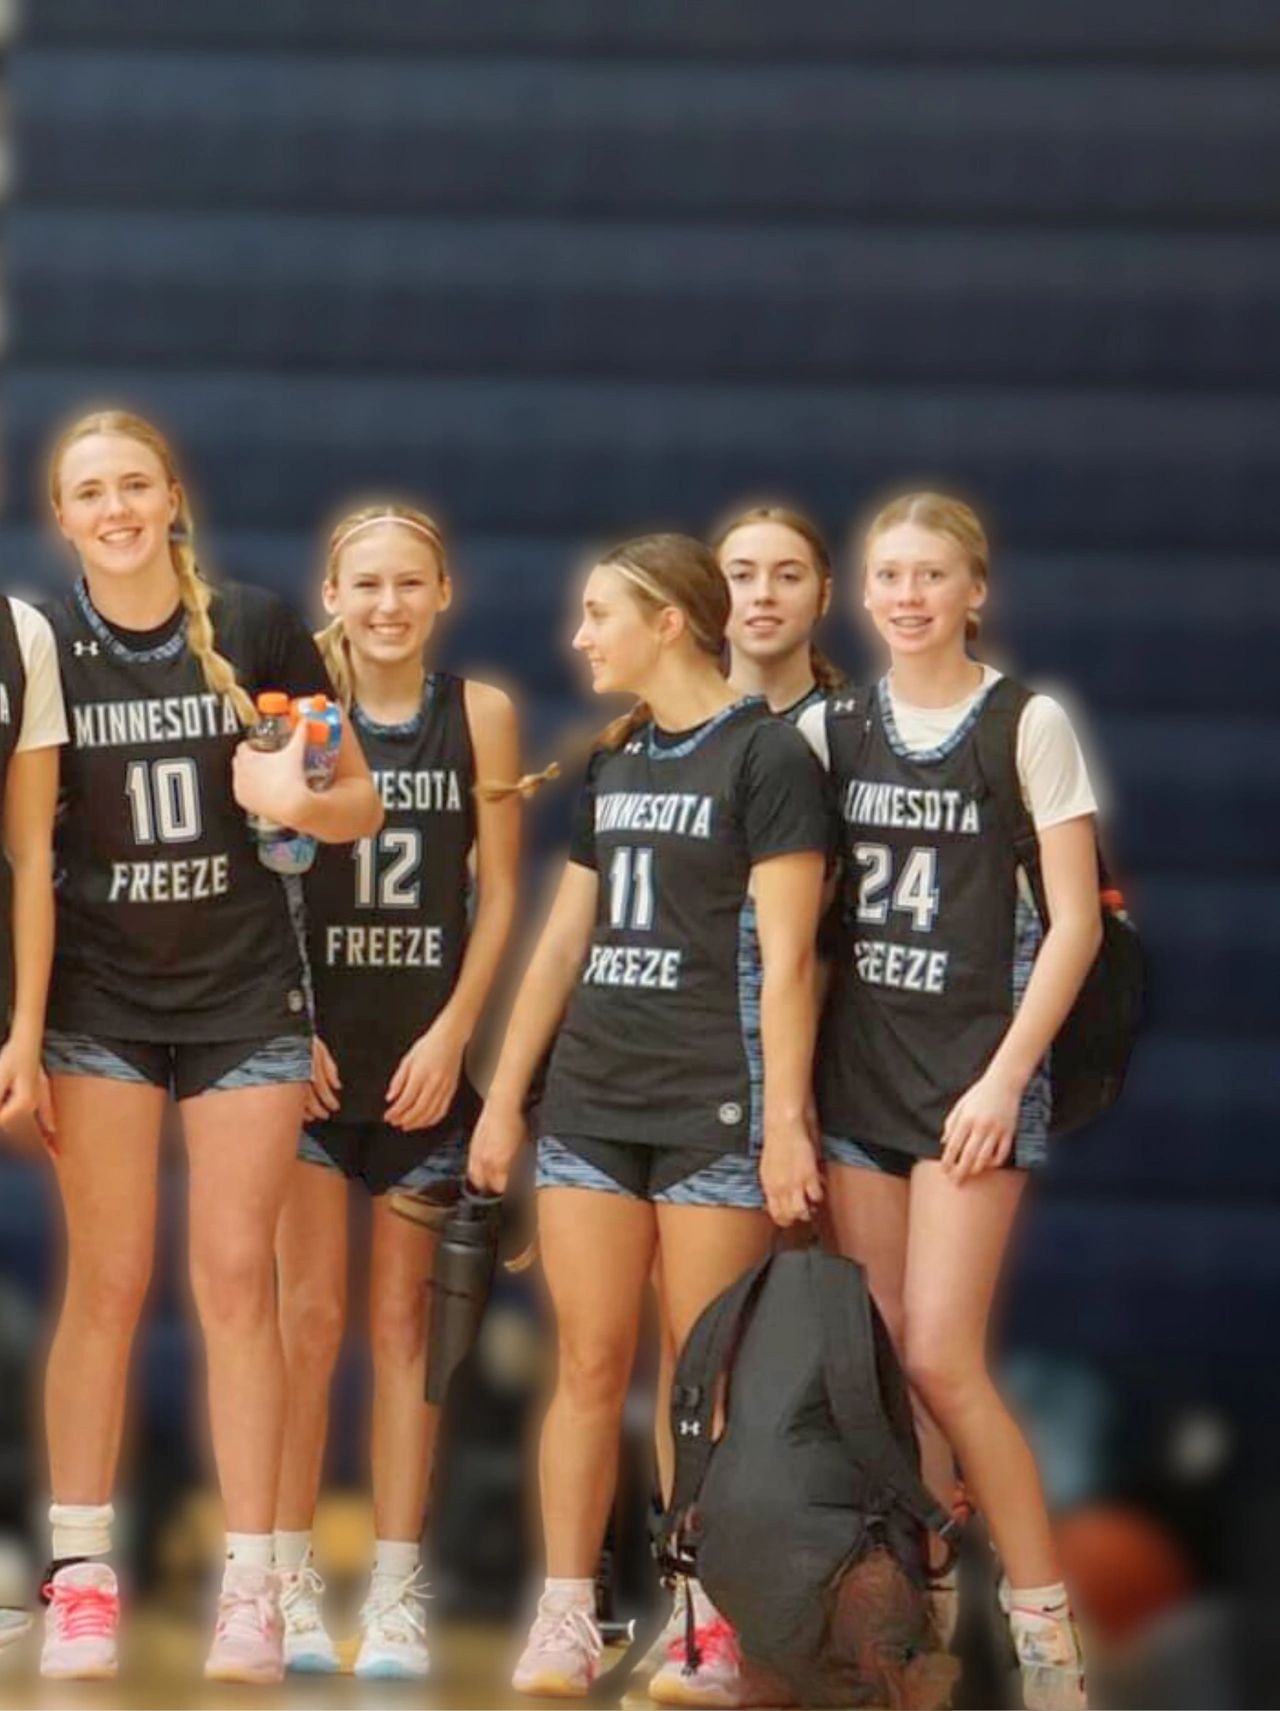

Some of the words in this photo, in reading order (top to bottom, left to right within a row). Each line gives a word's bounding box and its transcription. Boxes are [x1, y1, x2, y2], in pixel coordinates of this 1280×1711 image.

[73, 694, 239, 749] MINNESOTA
[125, 757, 202, 845] 10
[108, 854, 229, 902] FREEZE
[351, 828, 422, 909] 12
[609, 846, 655, 930] 11
[852, 842, 939, 932] 24
[326, 926, 442, 967] FREEZE
[582, 944, 682, 989] FREEZE
